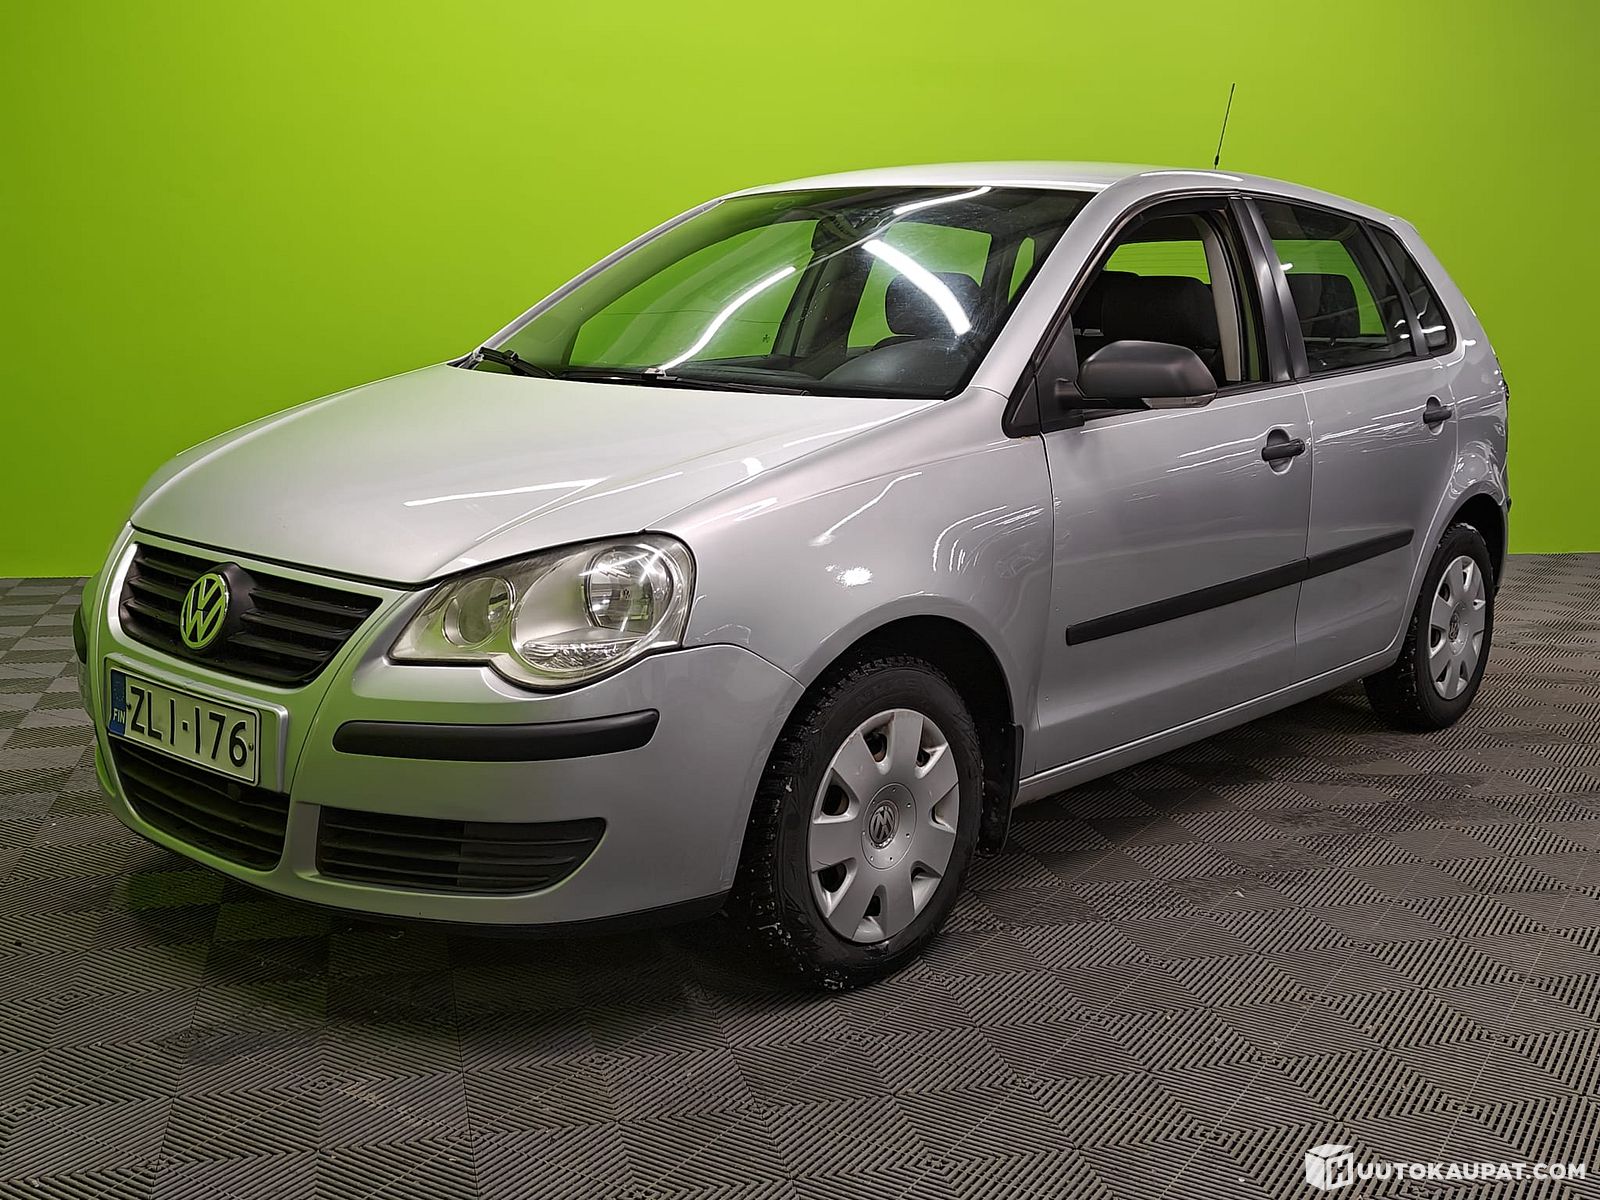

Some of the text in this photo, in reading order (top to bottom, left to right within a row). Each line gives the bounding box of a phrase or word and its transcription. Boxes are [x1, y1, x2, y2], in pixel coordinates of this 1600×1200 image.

[181, 574, 228, 649] VW
[113, 708, 126, 725] FIN
[130, 686, 247, 768] ZLI-176
